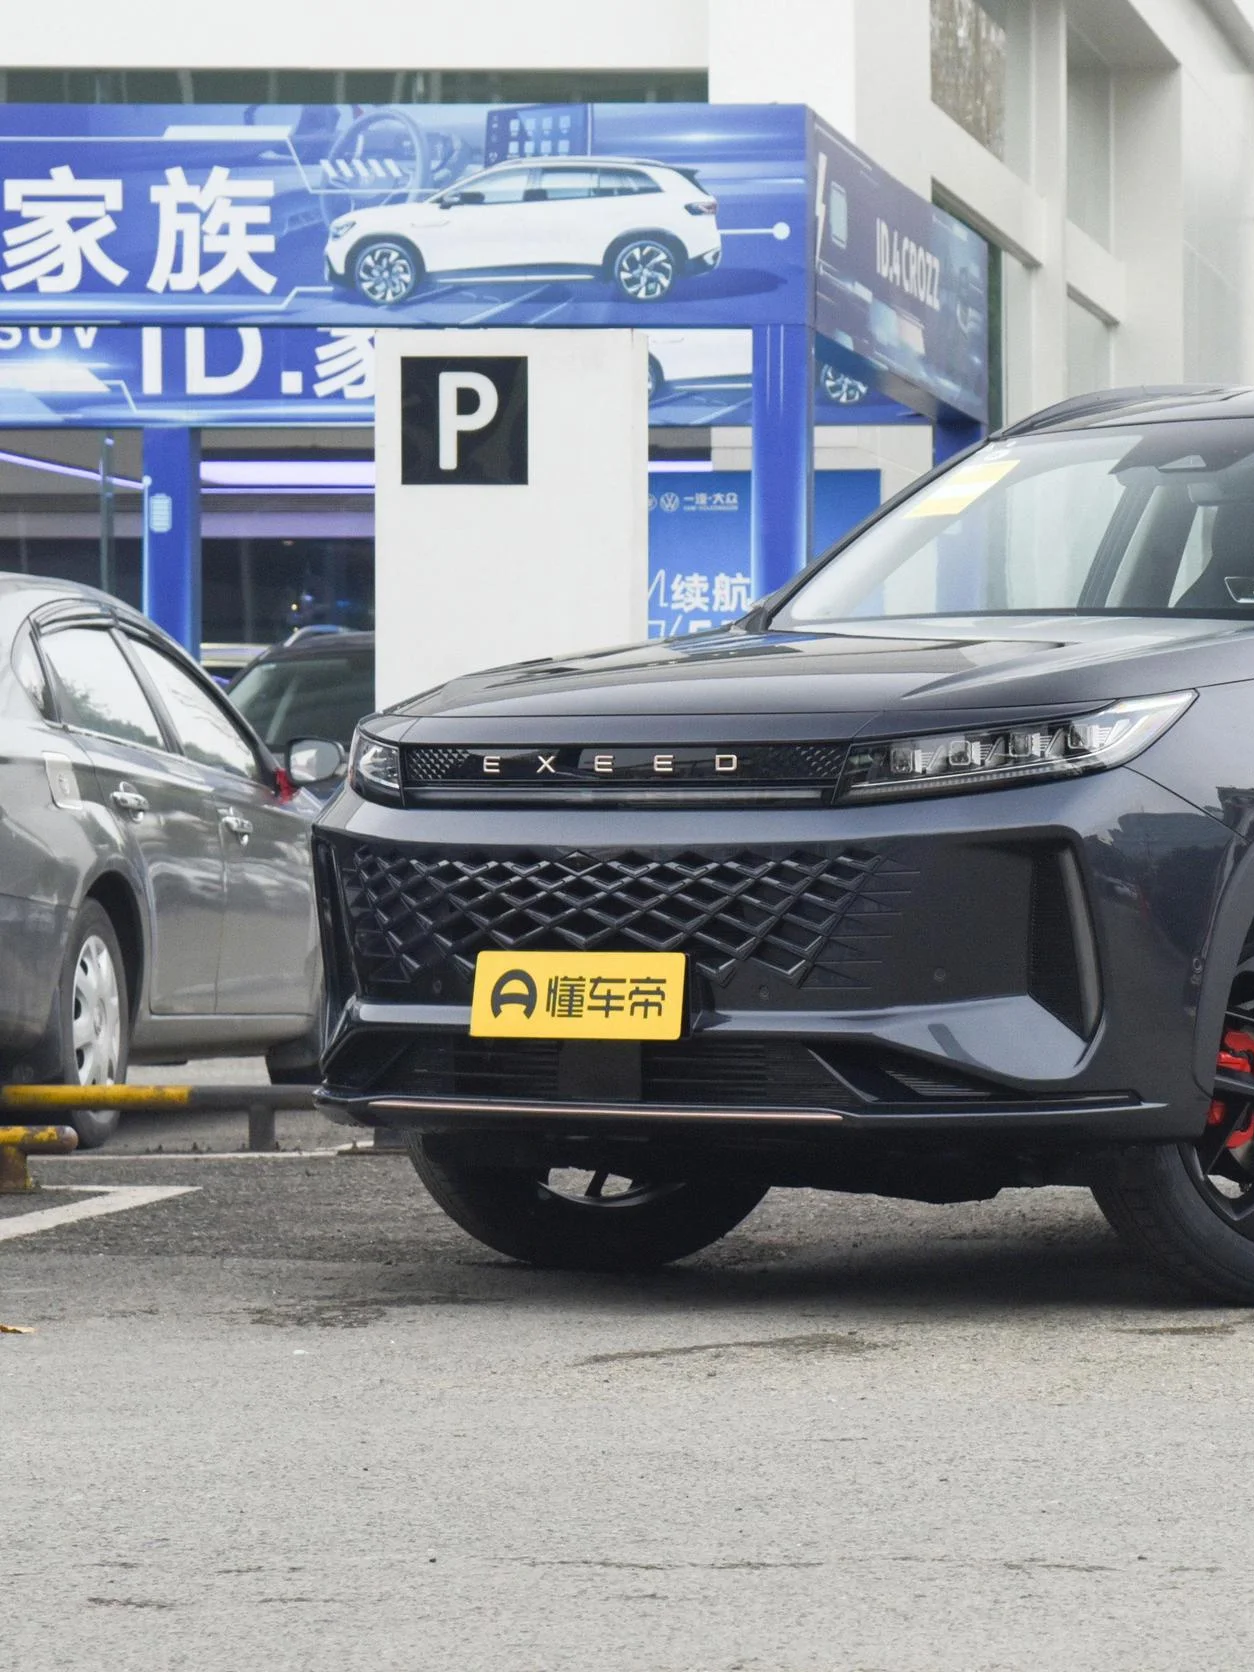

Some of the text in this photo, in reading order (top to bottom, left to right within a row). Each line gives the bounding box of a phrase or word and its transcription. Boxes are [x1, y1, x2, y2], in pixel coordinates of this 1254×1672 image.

[1, 165, 278, 294] 家族
[902, 236, 940, 312] CROZZ
[438, 371, 499, 470] P
[483, 754, 738, 774] EXEED
[546, 976, 667, 1019] 懂车帝
